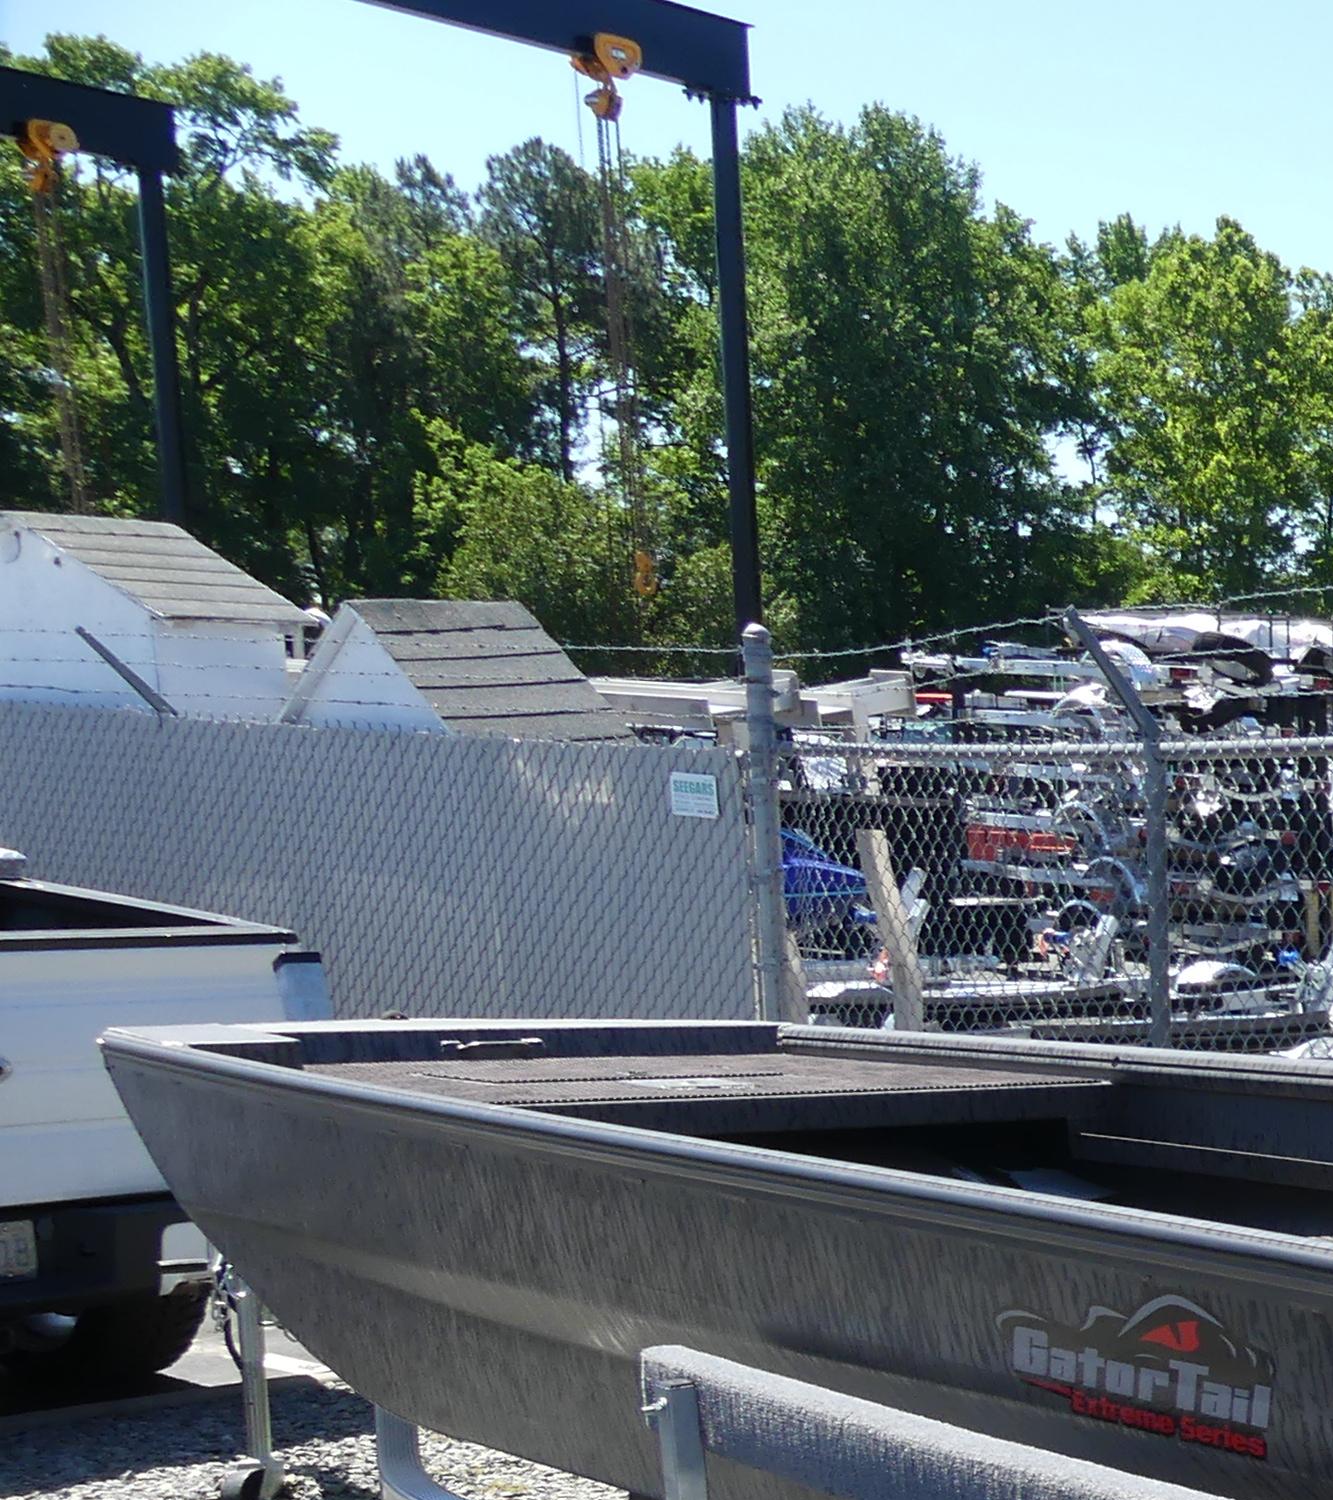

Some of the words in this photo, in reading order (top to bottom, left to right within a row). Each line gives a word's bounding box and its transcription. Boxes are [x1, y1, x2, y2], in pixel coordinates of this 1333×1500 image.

[1012, 1326, 1272, 1429] GatorTail
[1071, 1390, 1176, 1436] Extreme
[1180, 1415, 1268, 1458] Series
